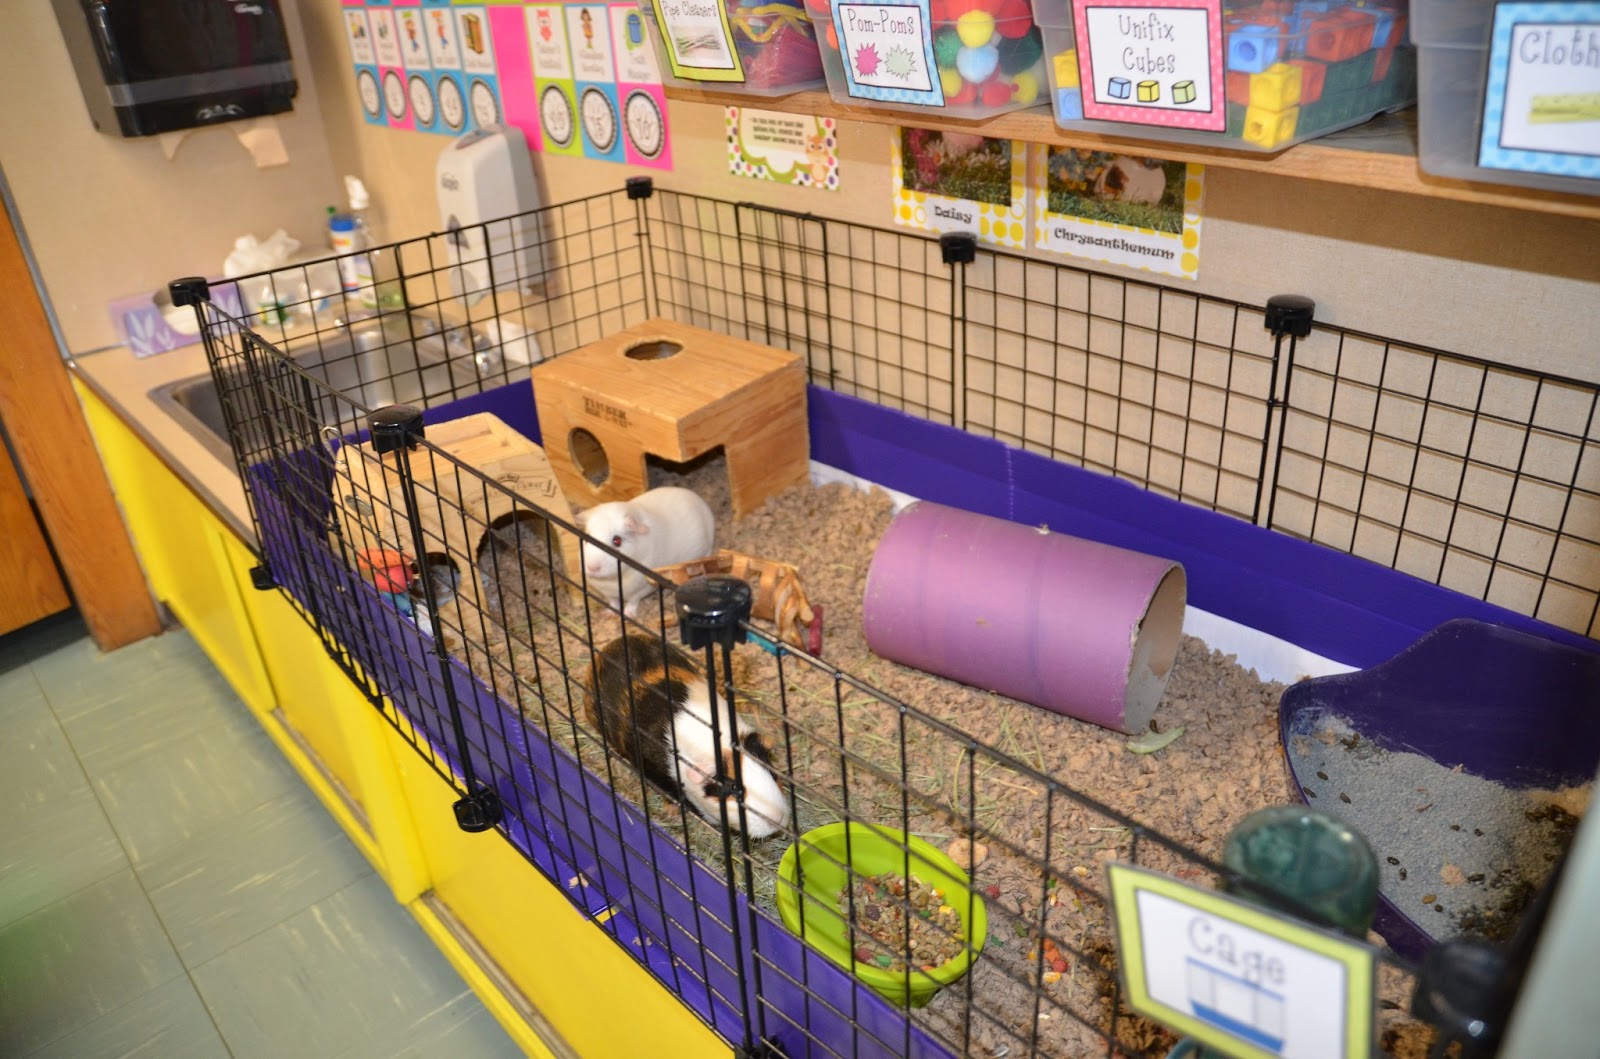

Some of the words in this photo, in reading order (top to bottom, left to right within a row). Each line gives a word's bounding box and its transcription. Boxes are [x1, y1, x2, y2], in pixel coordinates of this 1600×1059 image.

[662, 0, 680, 20] Pipe
[682, 1, 717, 17] Cleaners
[847, 8, 915, 34] Pom-Poms
[1118, 12, 1174, 41] Unifix
[1122, 46, 1176, 74] Cubes
[934, 204, 973, 224] Daisy
[1054, 226, 1175, 260] Chrysanthemum
[1188, 915, 1287, 988] Cage
